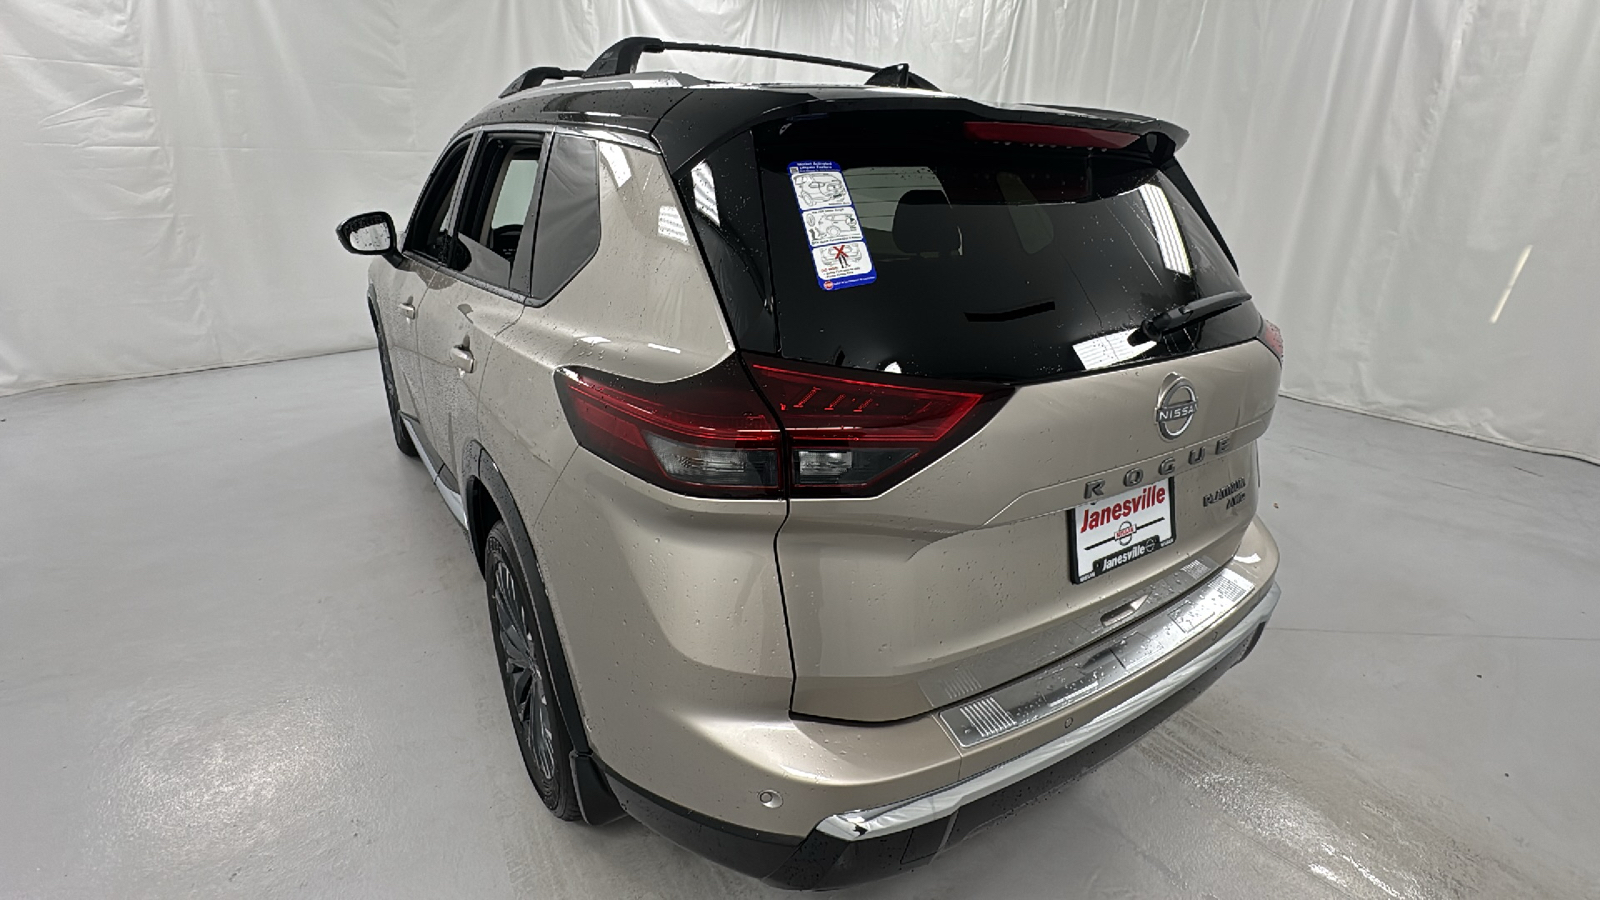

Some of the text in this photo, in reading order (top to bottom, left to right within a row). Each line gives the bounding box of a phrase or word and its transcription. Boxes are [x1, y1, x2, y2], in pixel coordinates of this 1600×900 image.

[1084, 437, 1230, 499] ROGUE
[1080, 485, 1166, 533] Janesville
[1102, 544, 1146, 571] Janesville
